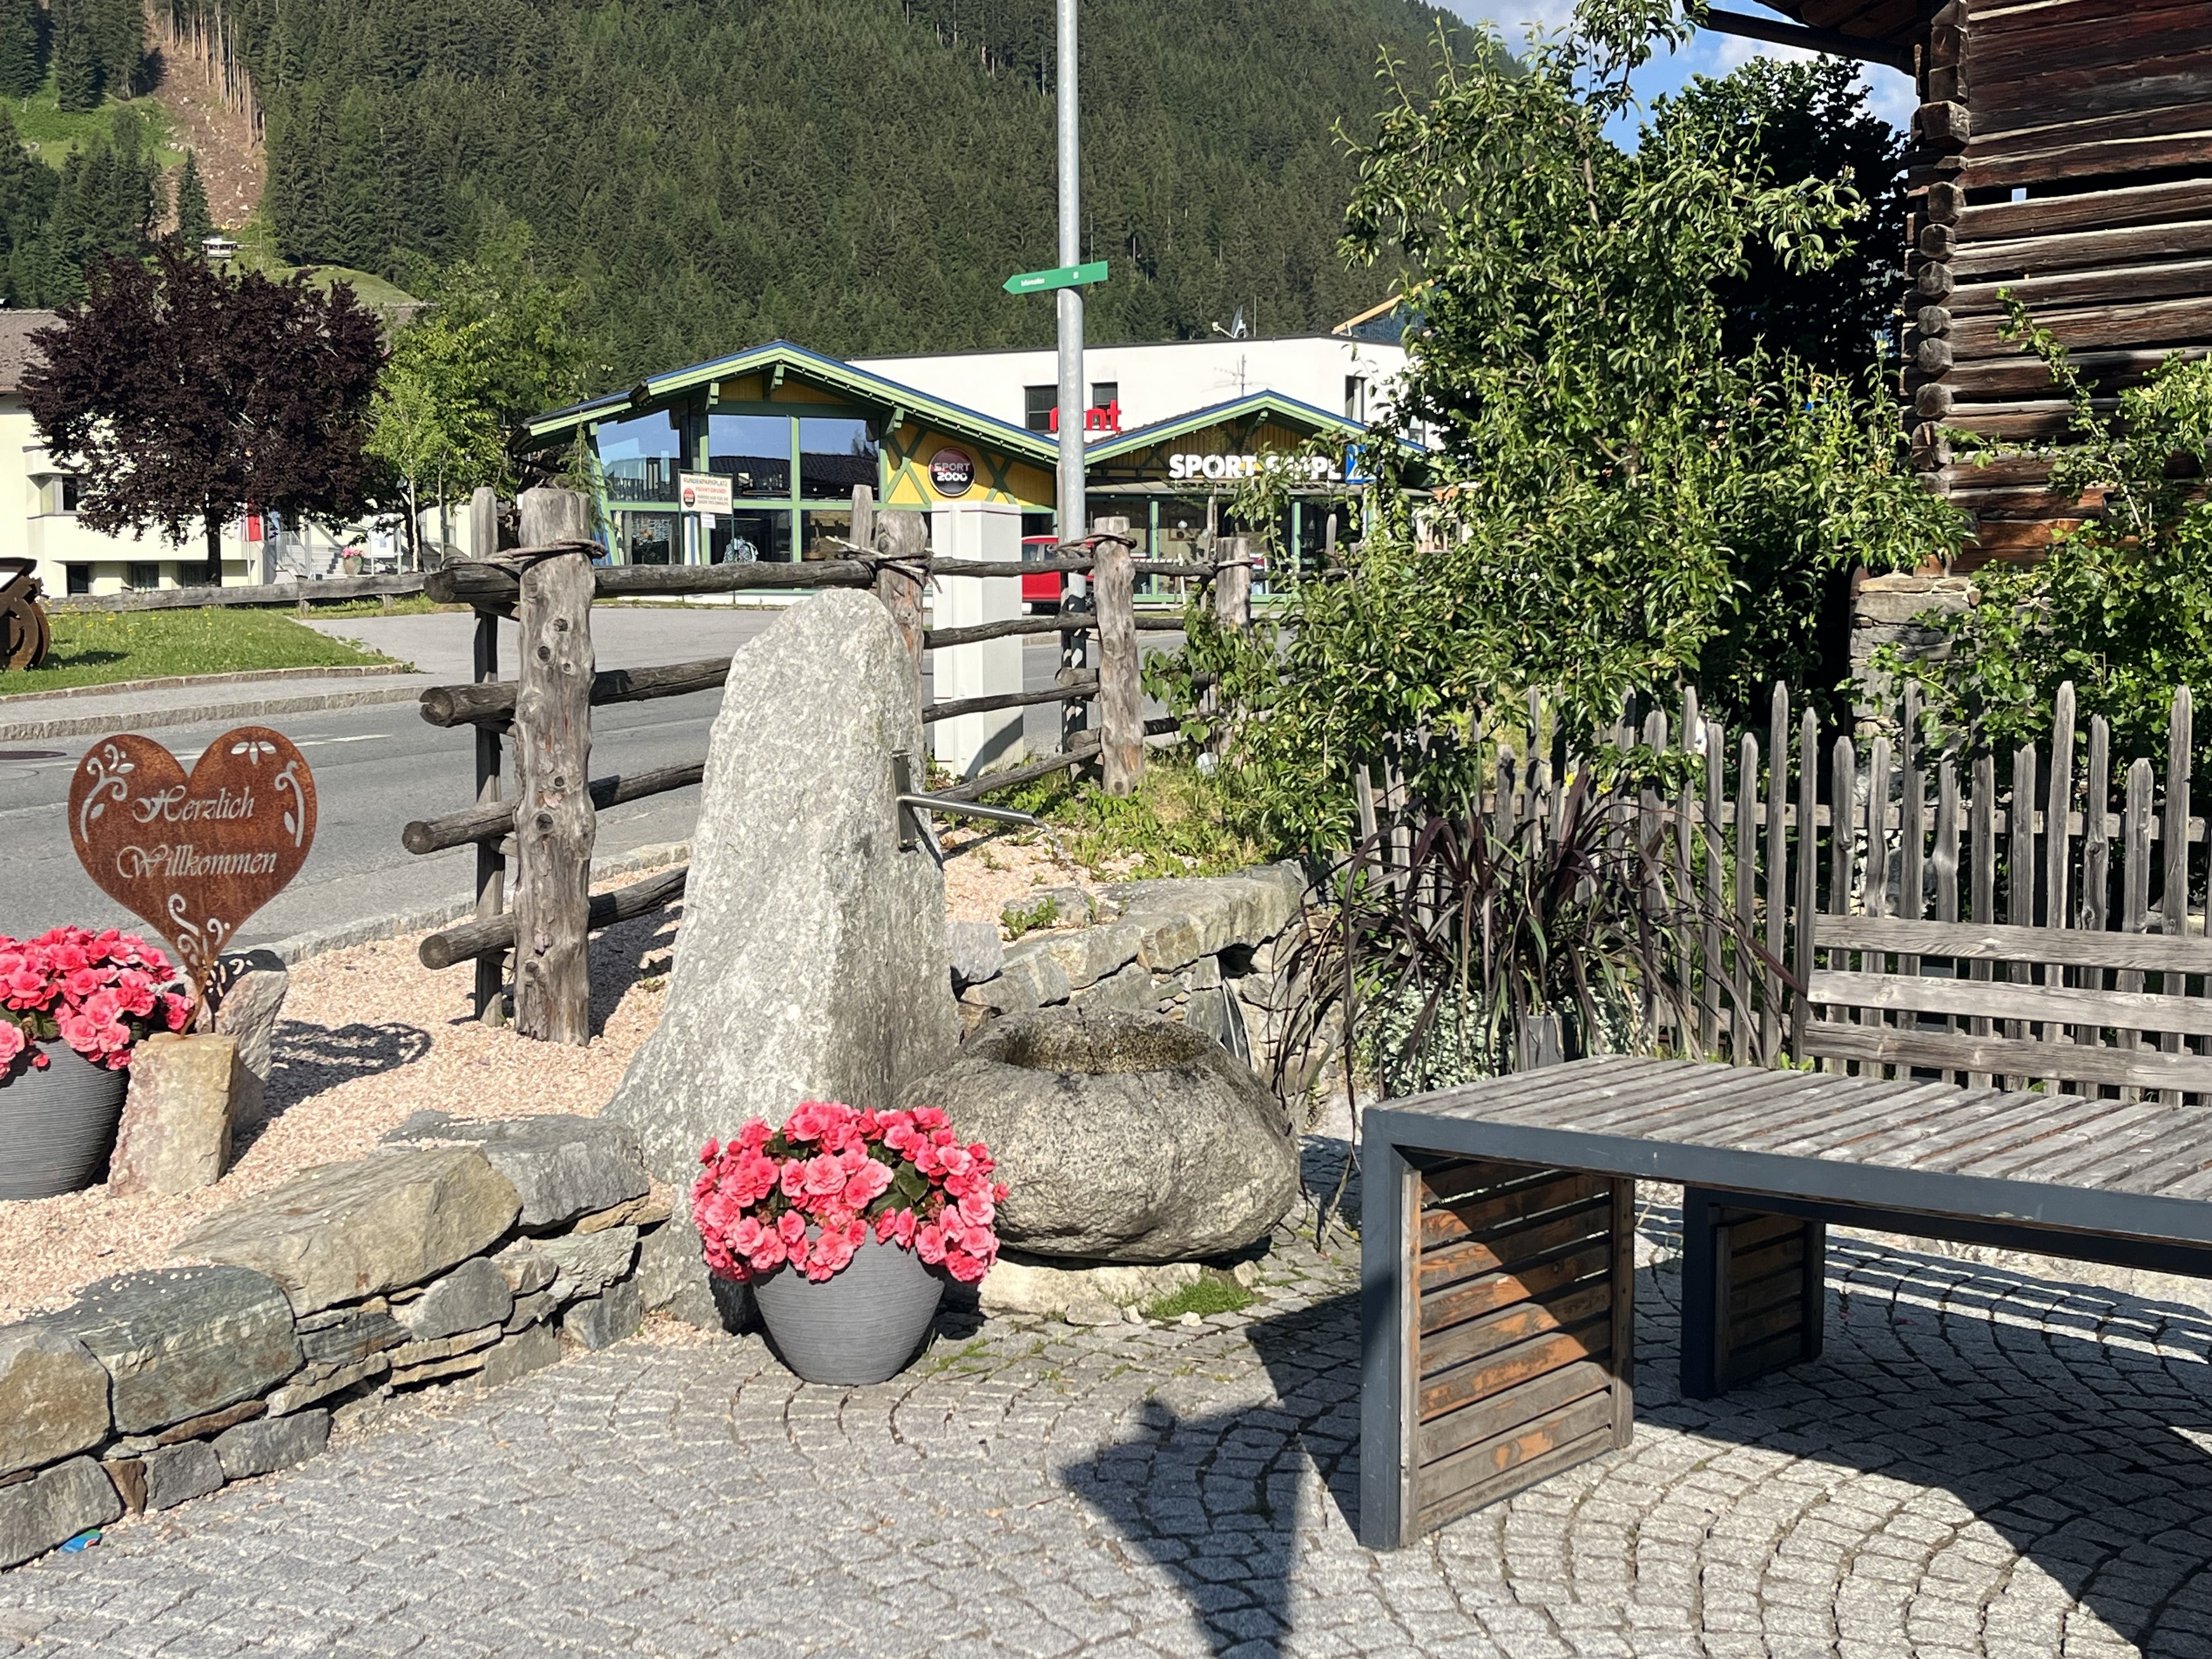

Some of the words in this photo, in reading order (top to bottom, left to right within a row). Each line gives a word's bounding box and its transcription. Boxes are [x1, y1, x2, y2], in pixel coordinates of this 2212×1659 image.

[1050, 399, 1122, 434] rnt
[934, 462, 971, 472] SPORT
[937, 472, 968, 482] 2000
[1168, 453, 1258, 479] SPORT
[132, 785, 255, 823] Herzlich
[116, 843, 277, 879] Willkommen
